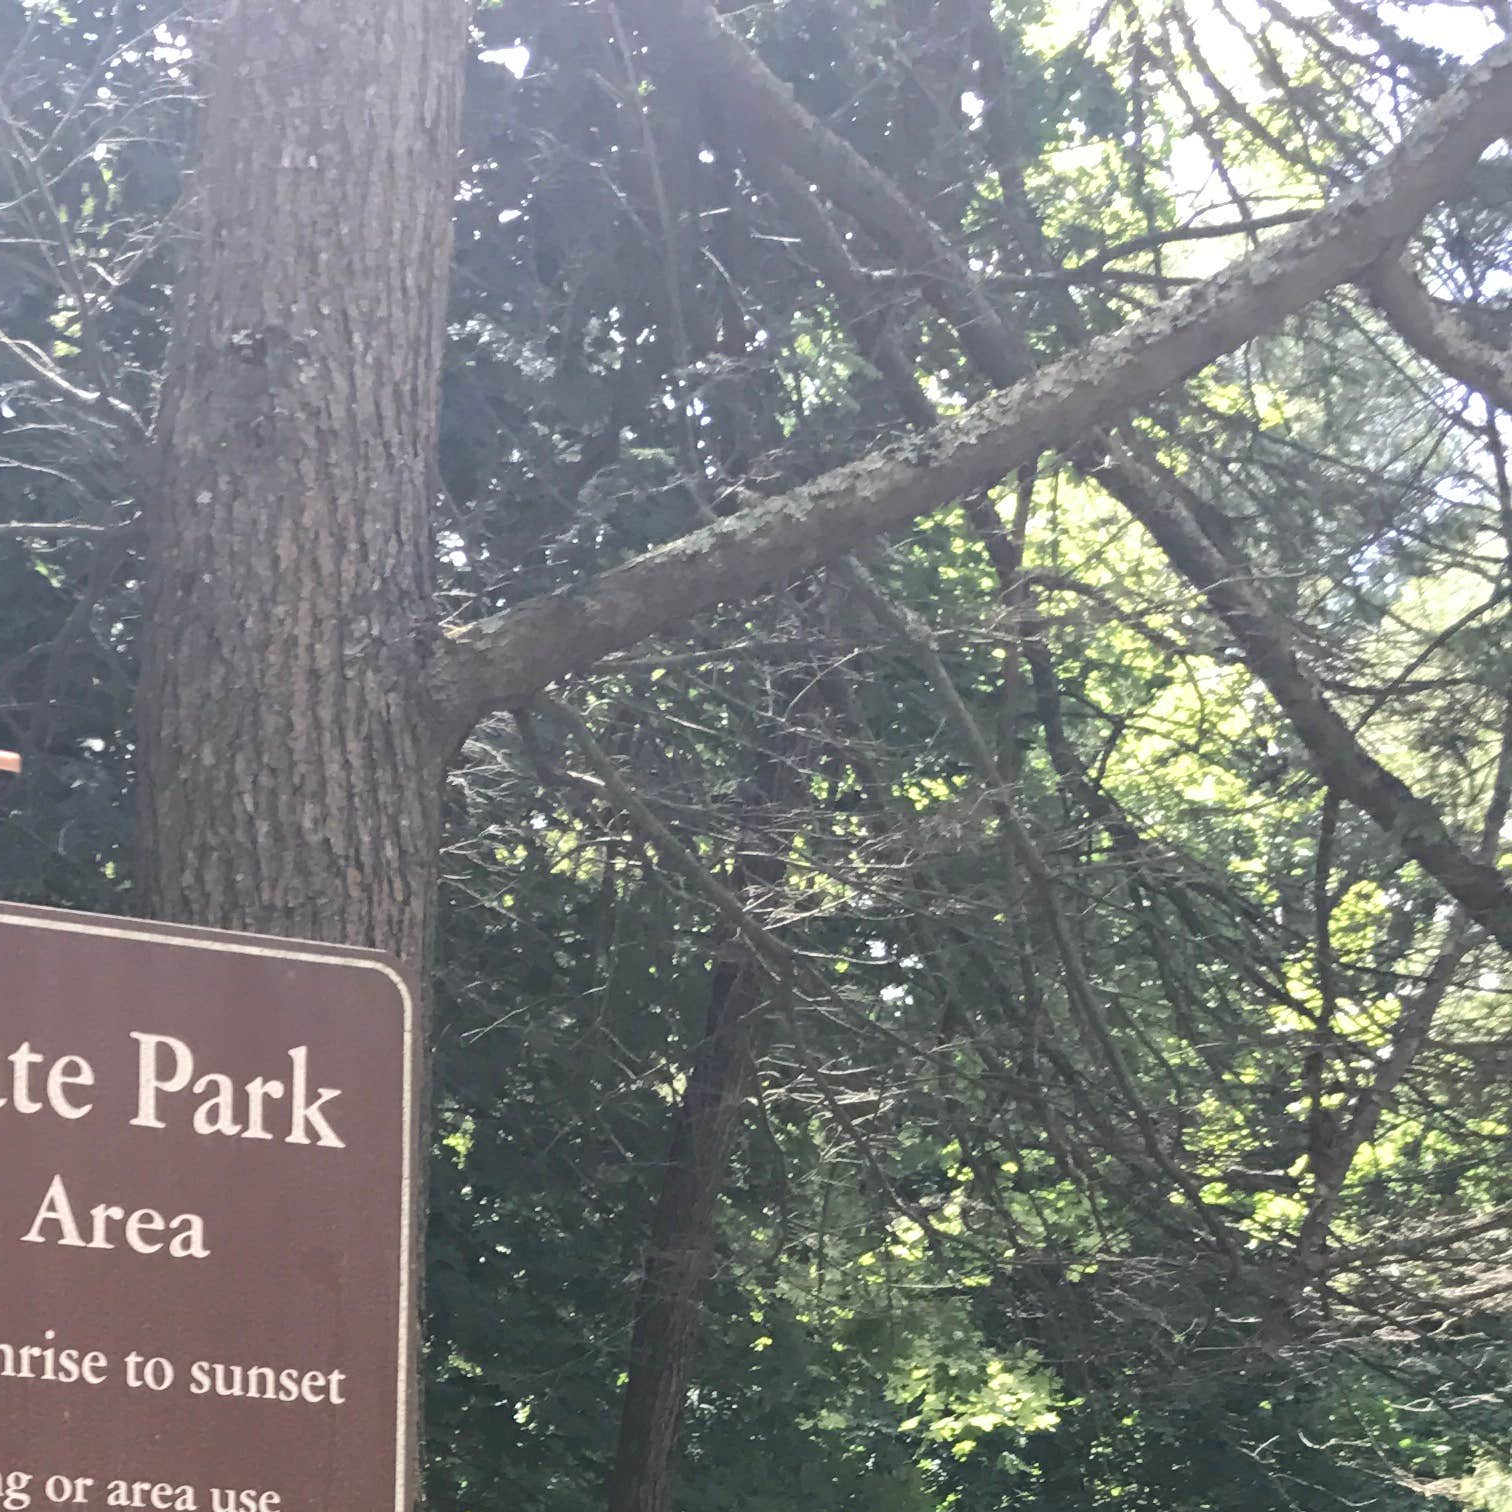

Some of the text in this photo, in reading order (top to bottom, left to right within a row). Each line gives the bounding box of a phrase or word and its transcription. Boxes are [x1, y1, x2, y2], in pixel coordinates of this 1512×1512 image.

[129, 1031, 346, 1148] Park
[20, 1174, 210, 1258] Area
[124, 1351, 174, 1390] to
[190, 1361, 346, 1404] sunset
[45, 1475, 94, 1503] or
[107, 1480, 198, 1511] area
